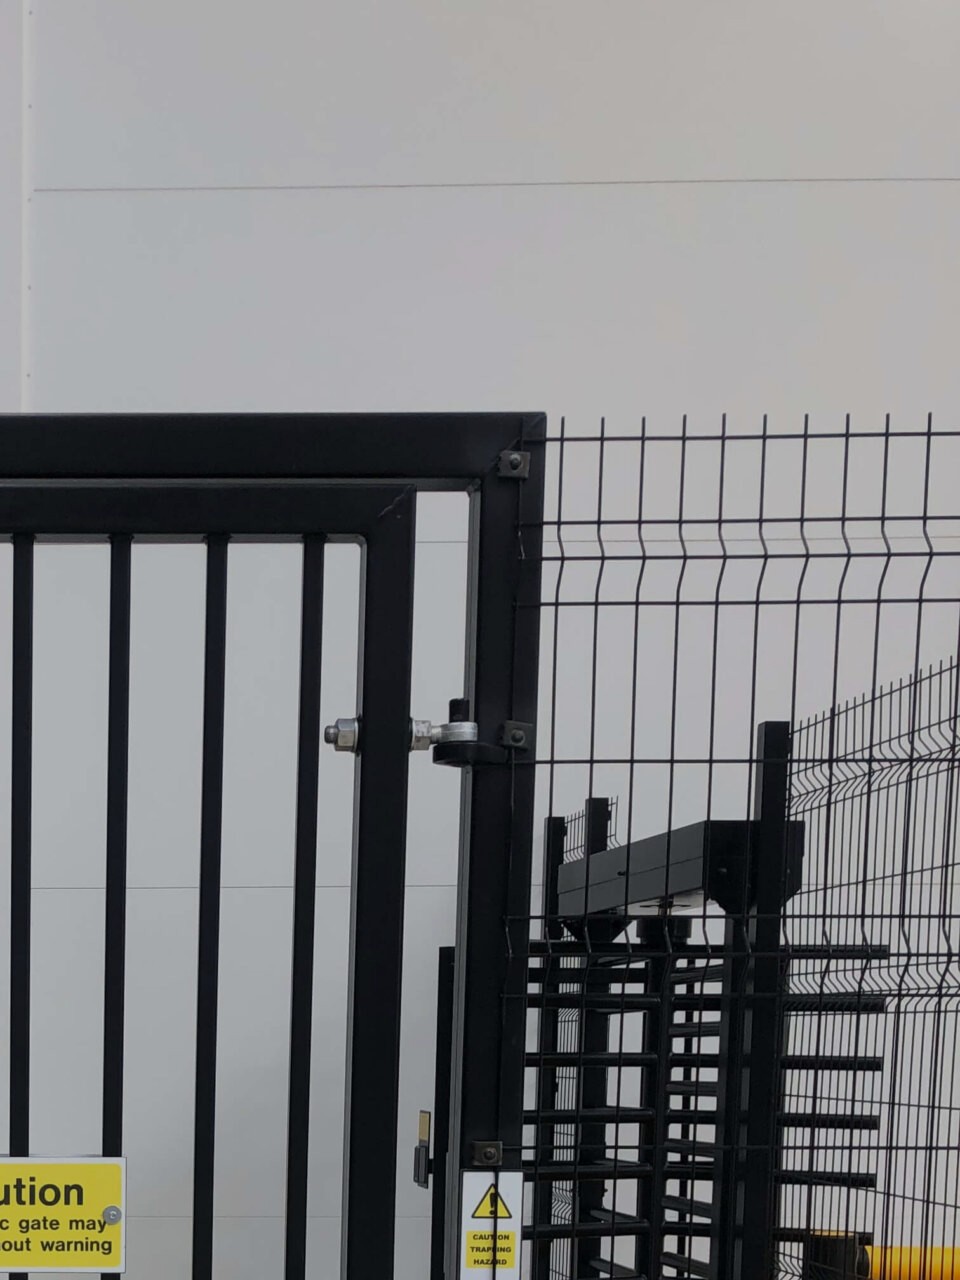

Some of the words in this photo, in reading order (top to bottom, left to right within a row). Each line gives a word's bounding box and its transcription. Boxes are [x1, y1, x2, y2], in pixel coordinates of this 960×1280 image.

[18, 1217, 60, 1233] gate
[69, 1218, 107, 1233] may
[40, 1237, 112, 1255] warning
